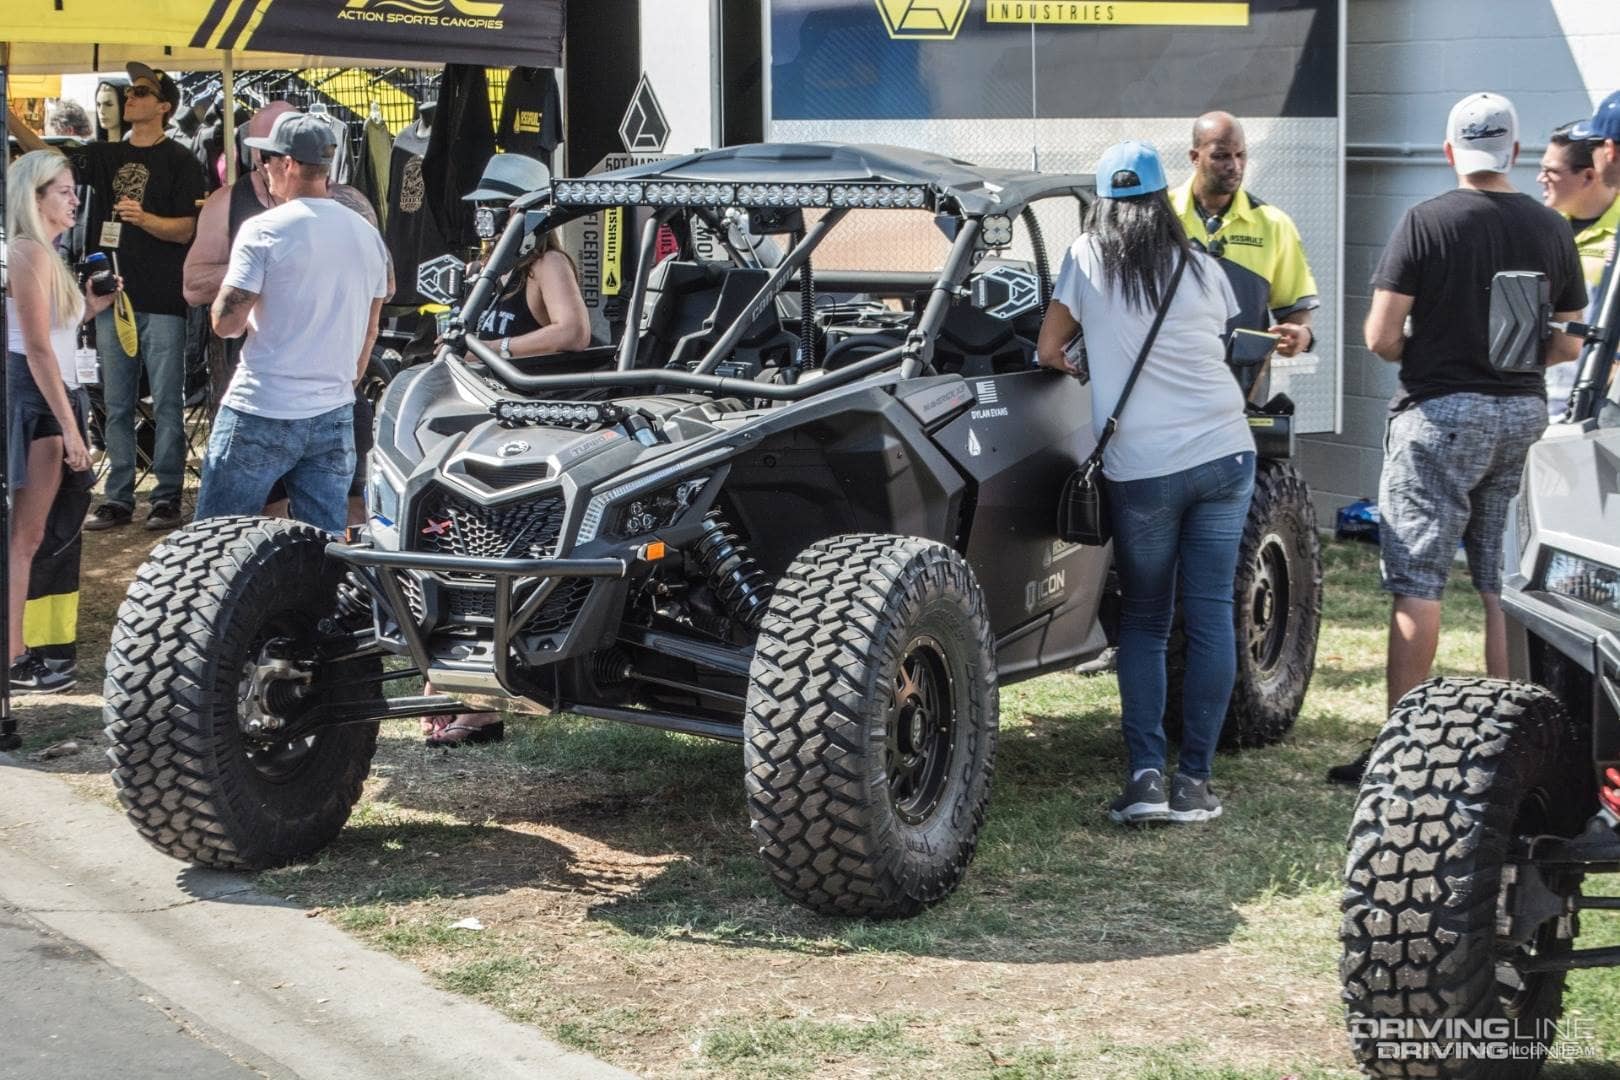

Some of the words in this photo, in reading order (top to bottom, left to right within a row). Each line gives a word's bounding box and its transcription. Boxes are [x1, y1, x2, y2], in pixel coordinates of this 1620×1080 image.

[337, 10, 384, 22] ACTION
[386, 13, 438, 26] SPORTS
[440, 16, 504, 30] CANOPIES
[990, 4, 1113, 20] INDUSTRIES
[583, 230, 599, 308] CERTIFIED
[971, 409, 991, 419] DYLAN
[991, 407, 1008, 417] EVANS
[1037, 569, 1065, 600] ICON
